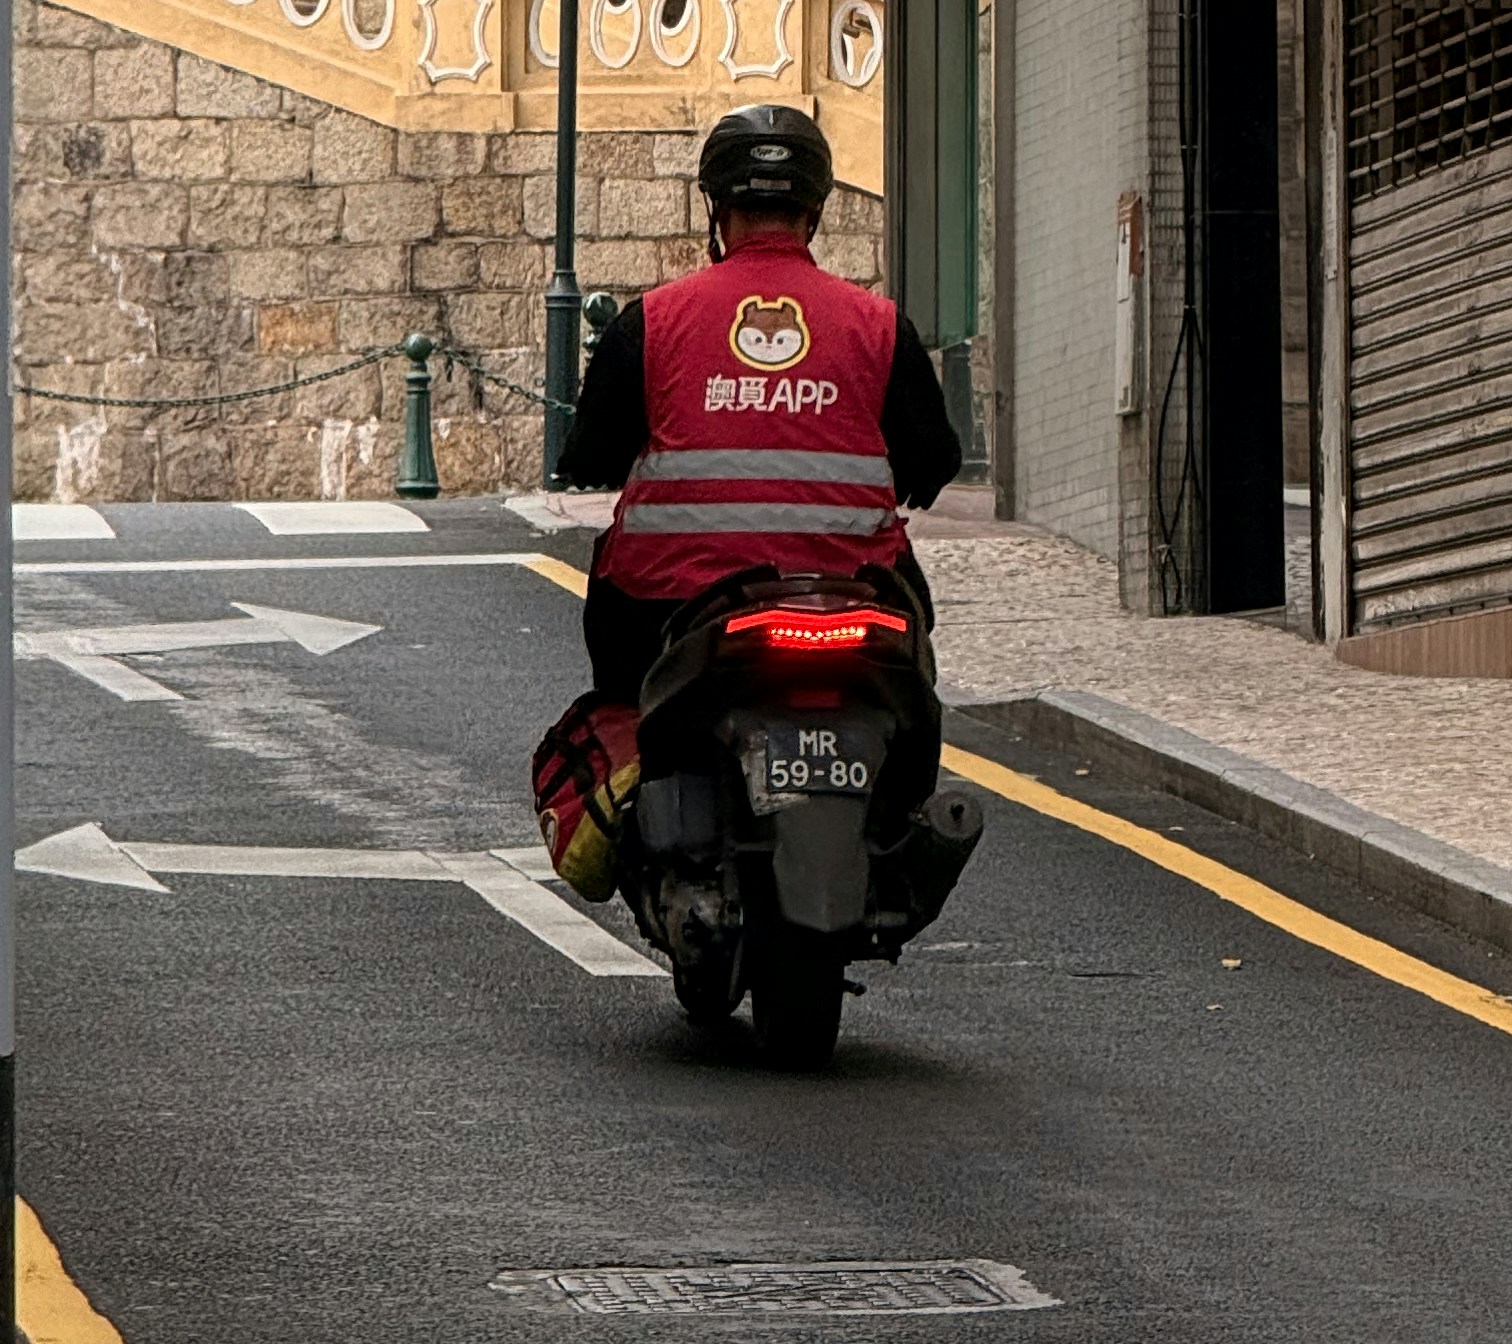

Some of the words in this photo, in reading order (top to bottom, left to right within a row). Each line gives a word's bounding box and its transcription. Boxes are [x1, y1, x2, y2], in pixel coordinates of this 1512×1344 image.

[704, 373, 838, 415] 澳覓APP
[798, 730, 838, 757] MR
[771, 760, 868, 788] 59-80
